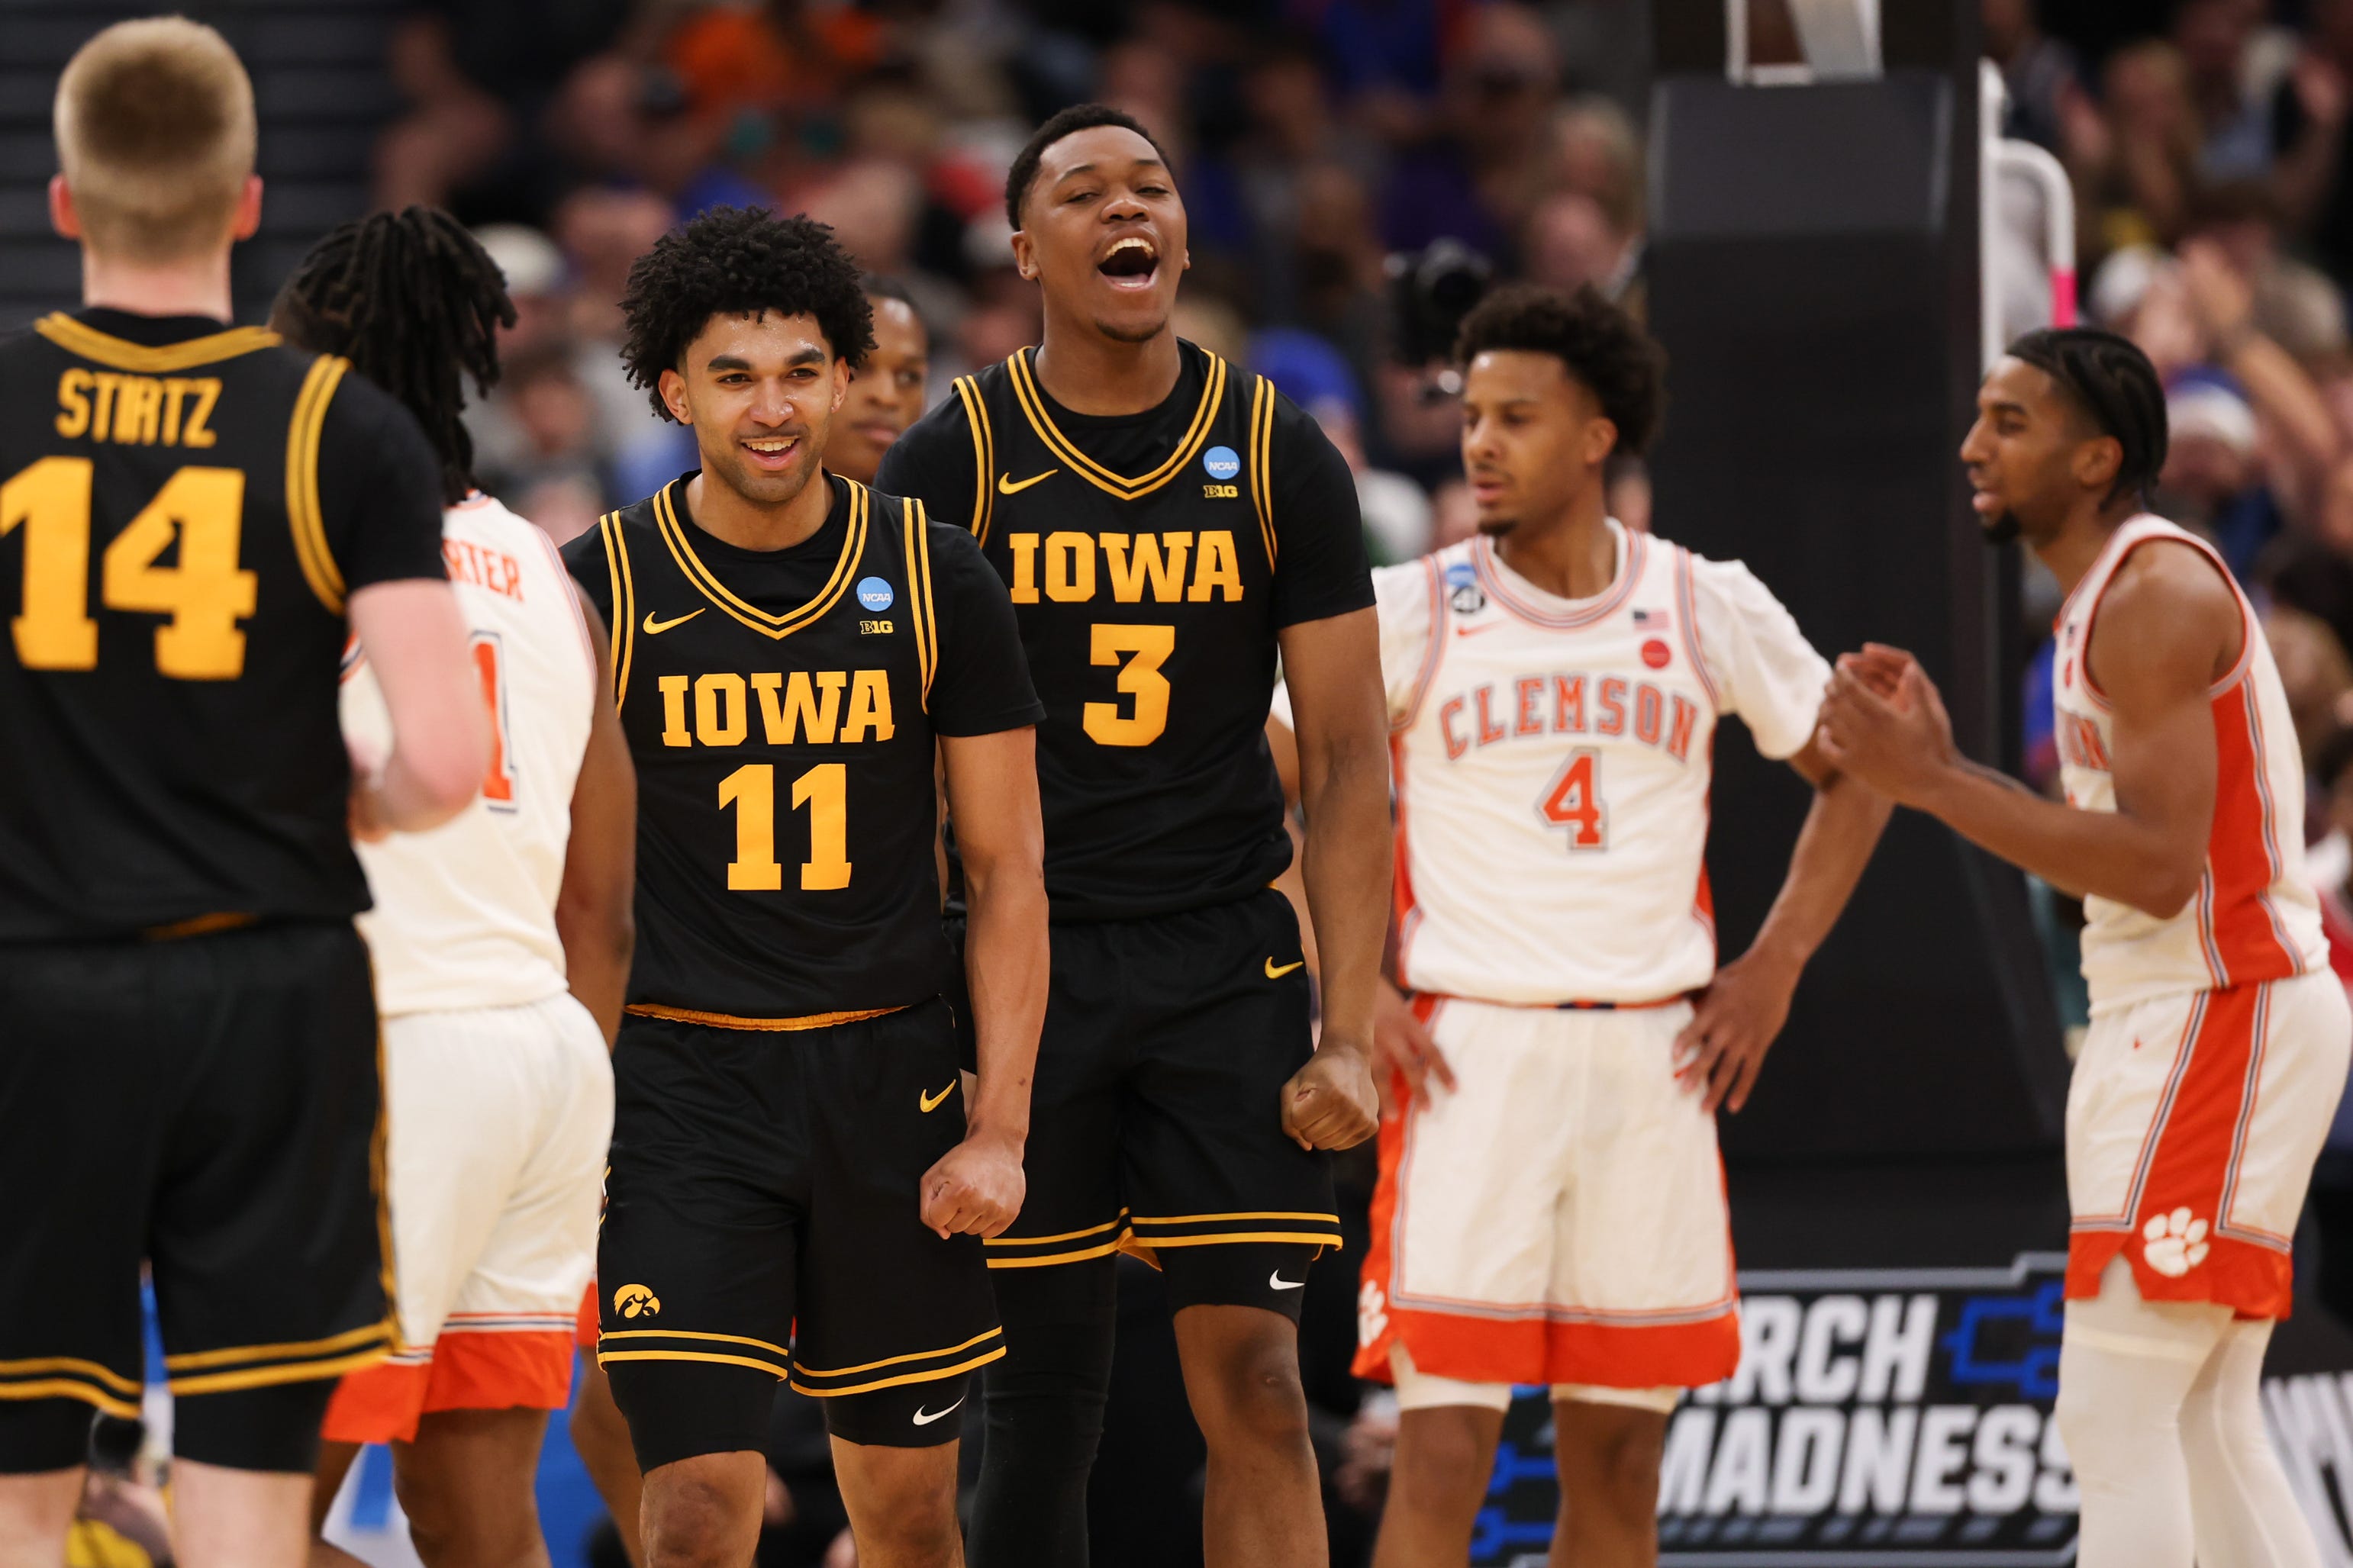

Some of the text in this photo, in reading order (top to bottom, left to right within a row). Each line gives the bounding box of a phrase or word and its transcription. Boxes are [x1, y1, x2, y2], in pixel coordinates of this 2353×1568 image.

[54, 367, 224, 449] STIRTZ
[1208, 461, 1238, 471] NCAA
[0, 456, 258, 681] 14
[441, 537, 527, 602] RTER
[862, 592, 891, 603] NCAA
[1009, 530, 1244, 604] IOWA
[658, 669, 895, 747] IOWA
[1082, 623, 1176, 747] 3
[1438, 671, 1698, 765] CLEMSON
[718, 763, 853, 891] 11
[1534, 745, 1608, 853] 4
[1681, 1294, 1939, 1403] RCH
